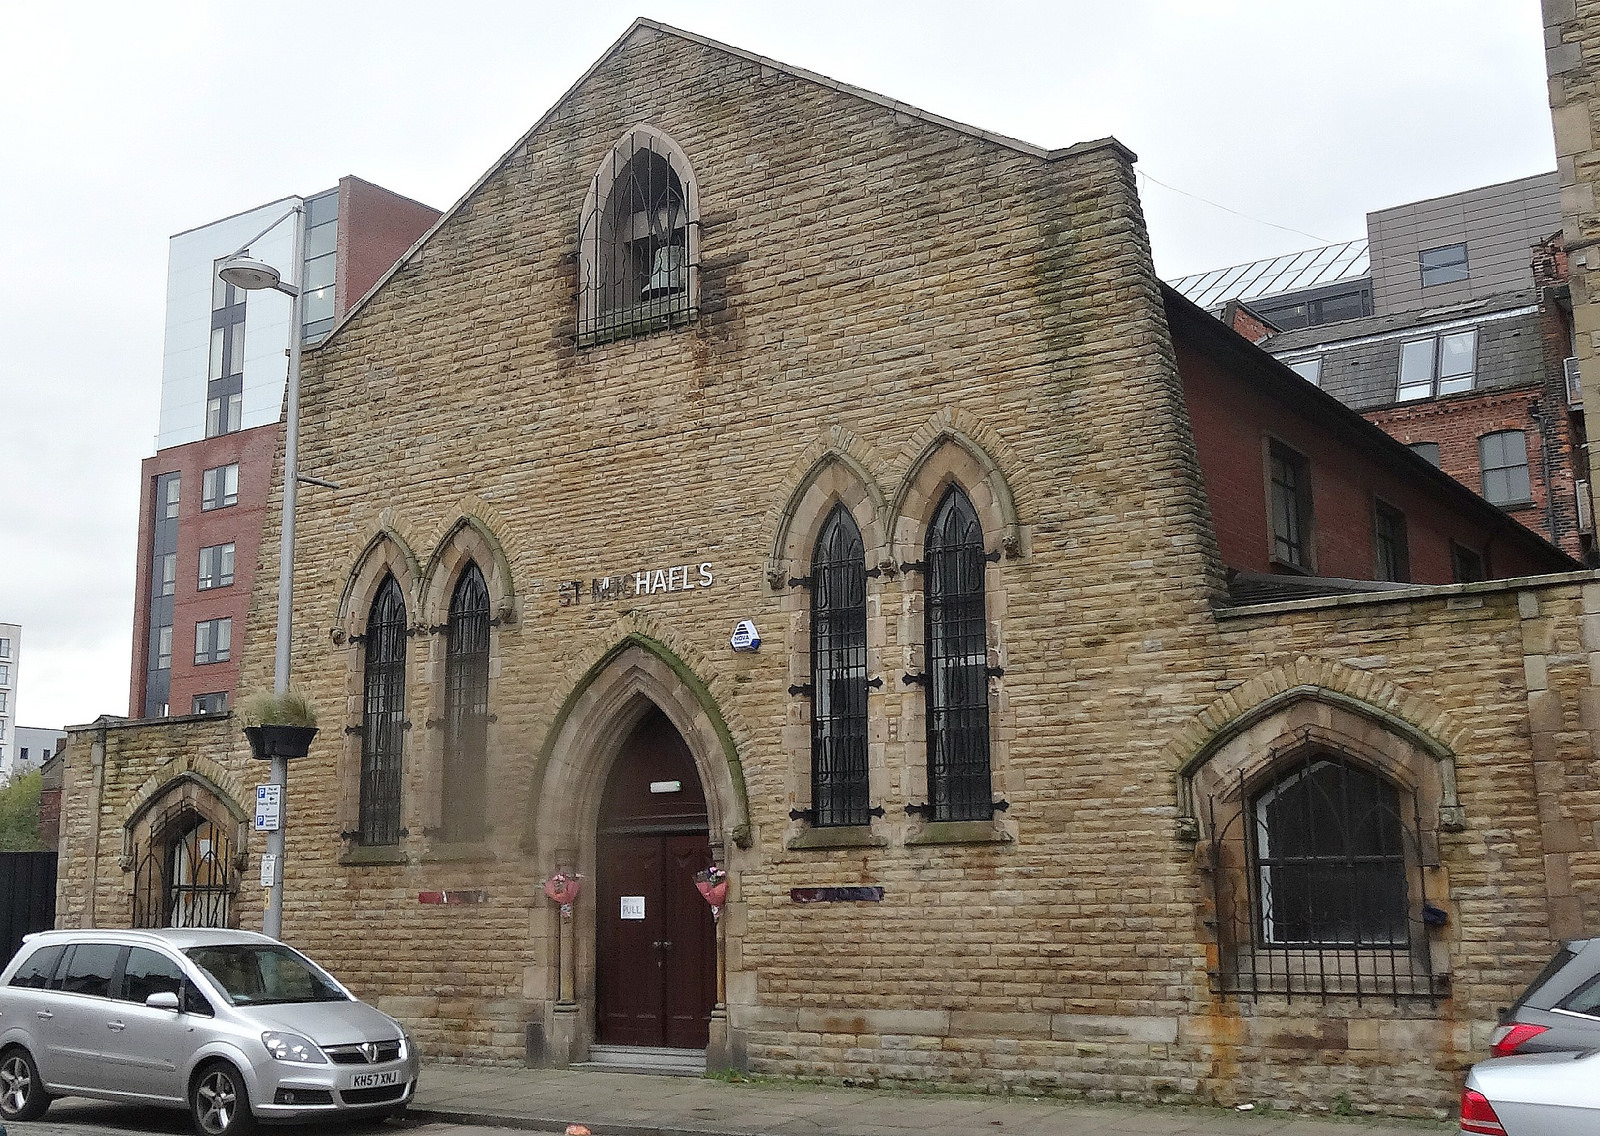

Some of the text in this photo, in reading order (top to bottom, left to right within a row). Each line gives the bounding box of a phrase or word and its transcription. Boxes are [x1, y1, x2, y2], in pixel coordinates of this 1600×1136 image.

[558, 580, 582, 607] ST
[622, 904, 642, 915] PULL
[354, 1072, 397, 1087] KH57 XNJ
